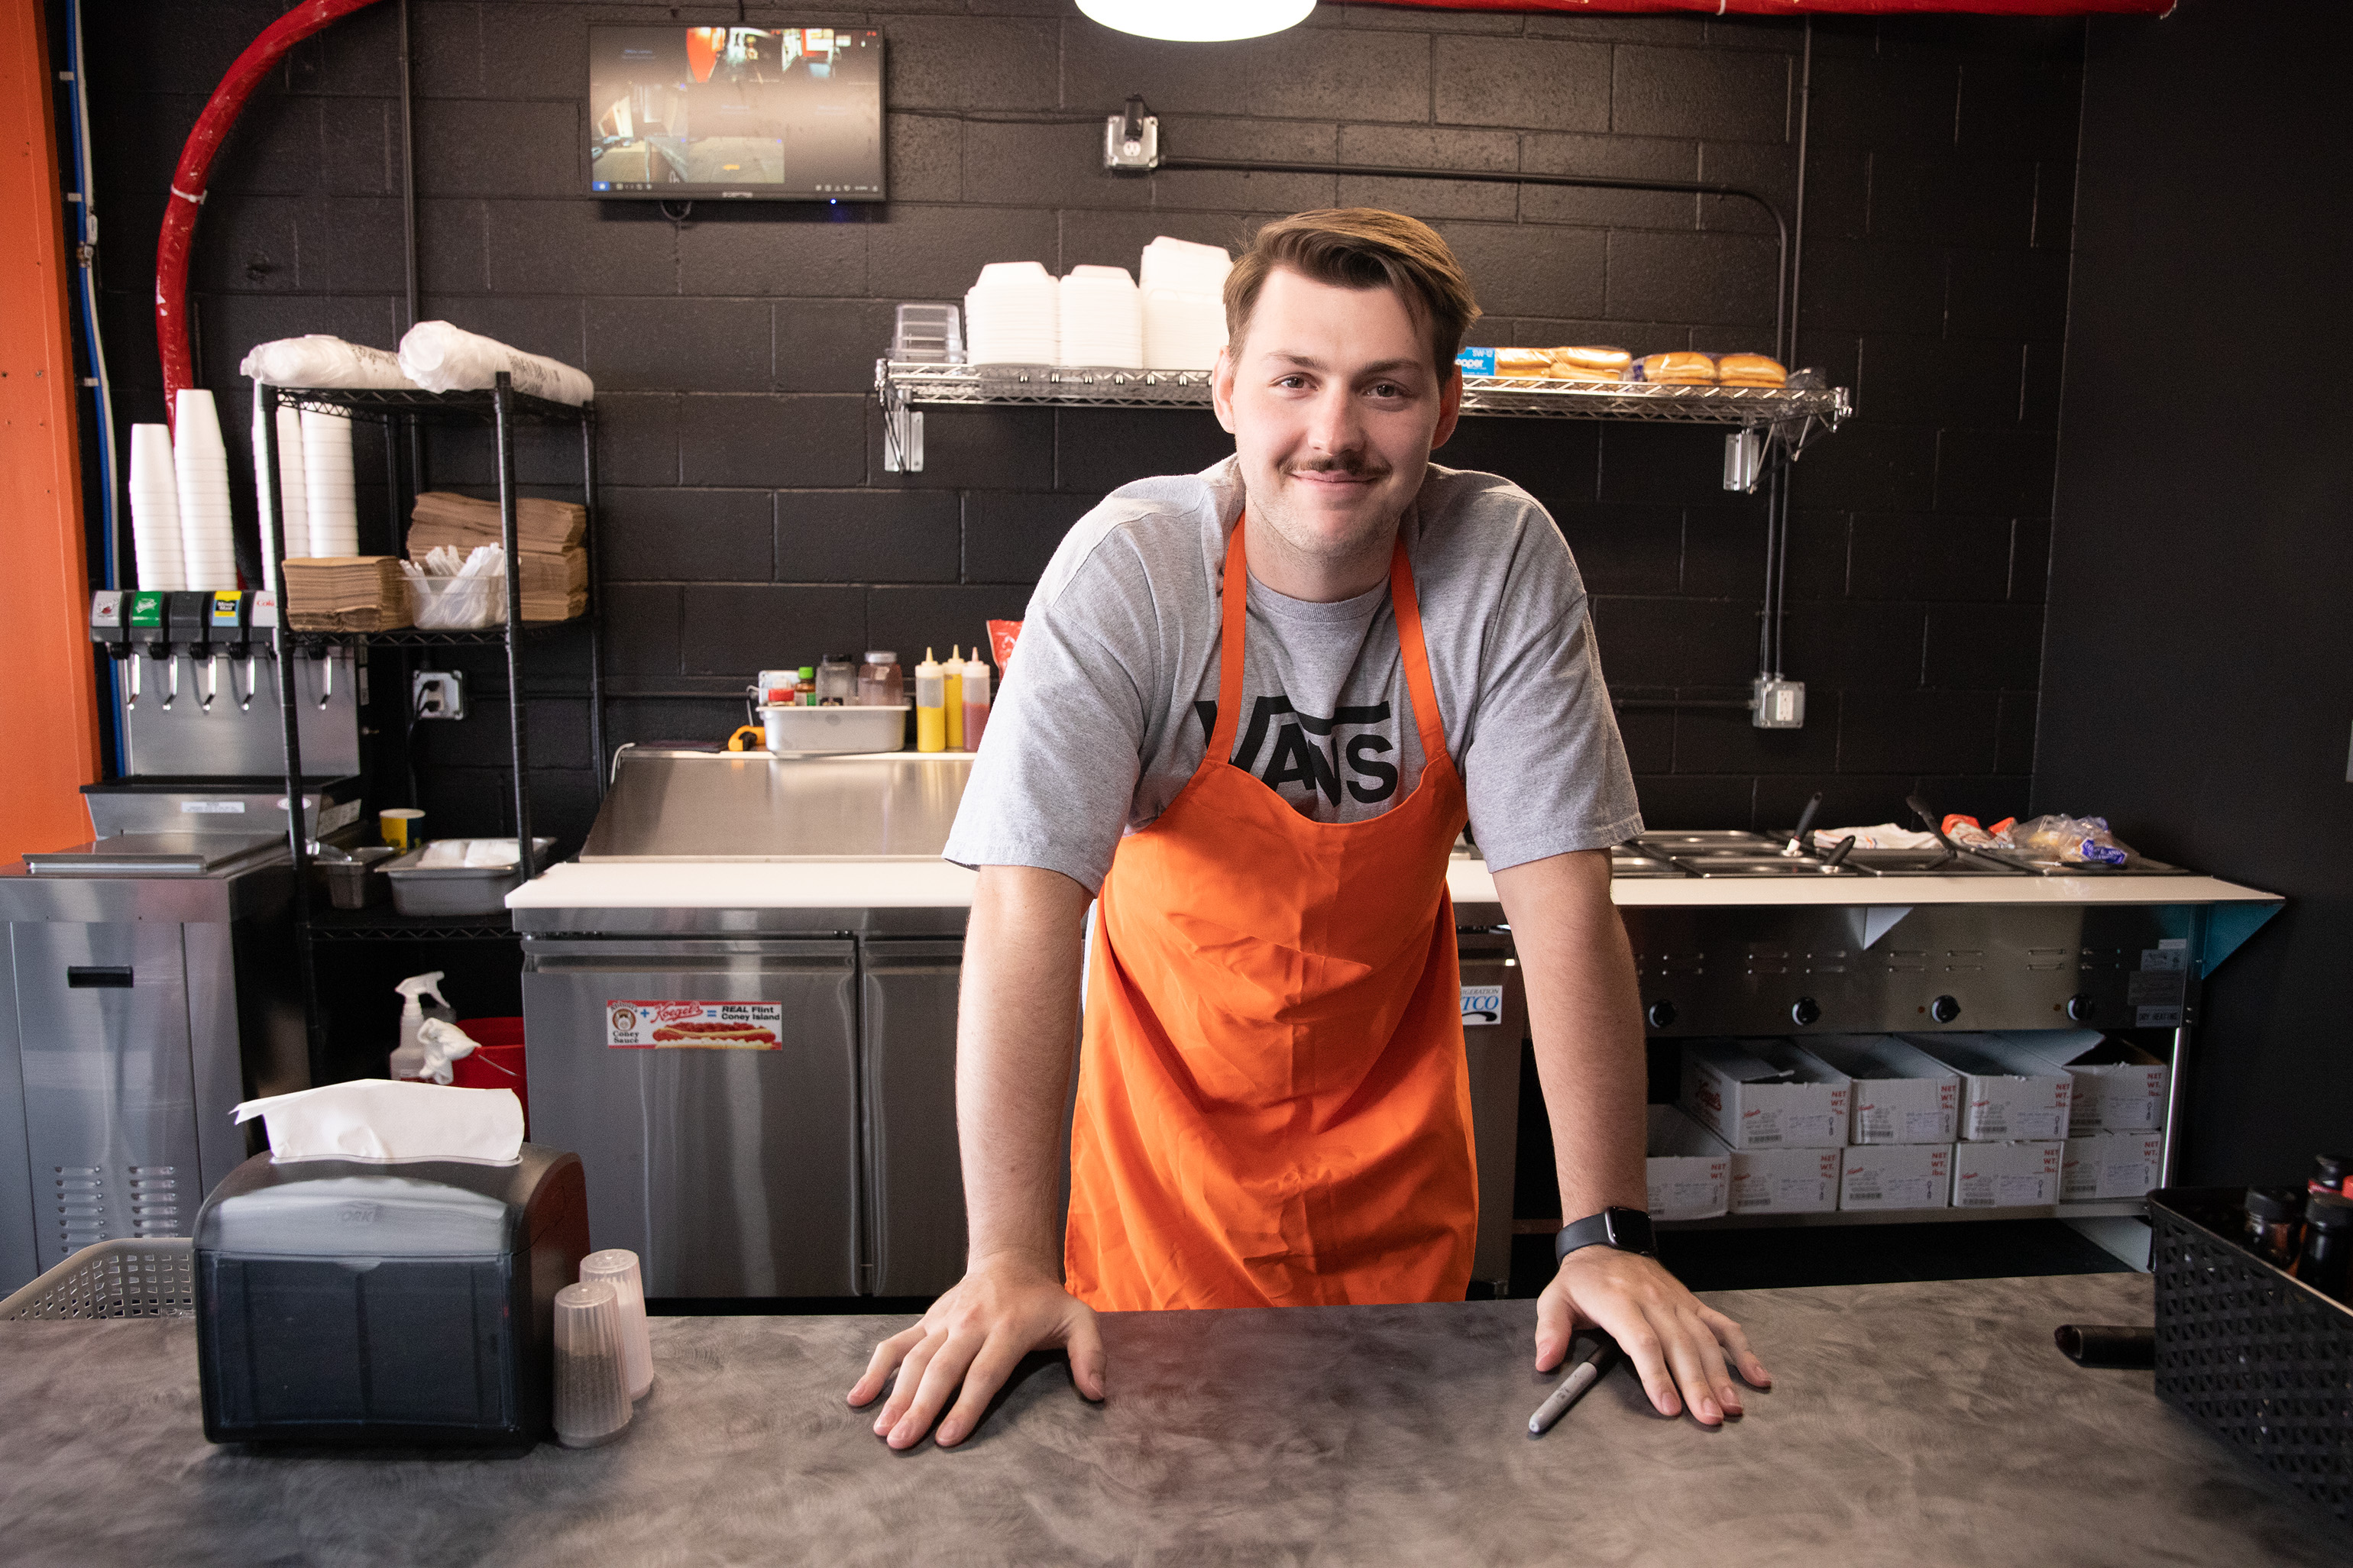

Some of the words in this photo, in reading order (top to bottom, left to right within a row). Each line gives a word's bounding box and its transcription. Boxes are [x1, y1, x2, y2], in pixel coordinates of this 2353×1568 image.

[1193, 696, 1399, 807] VANS
[650, 1001, 704, 1023] Koegel's
[721, 1013, 750, 1021] Coney
